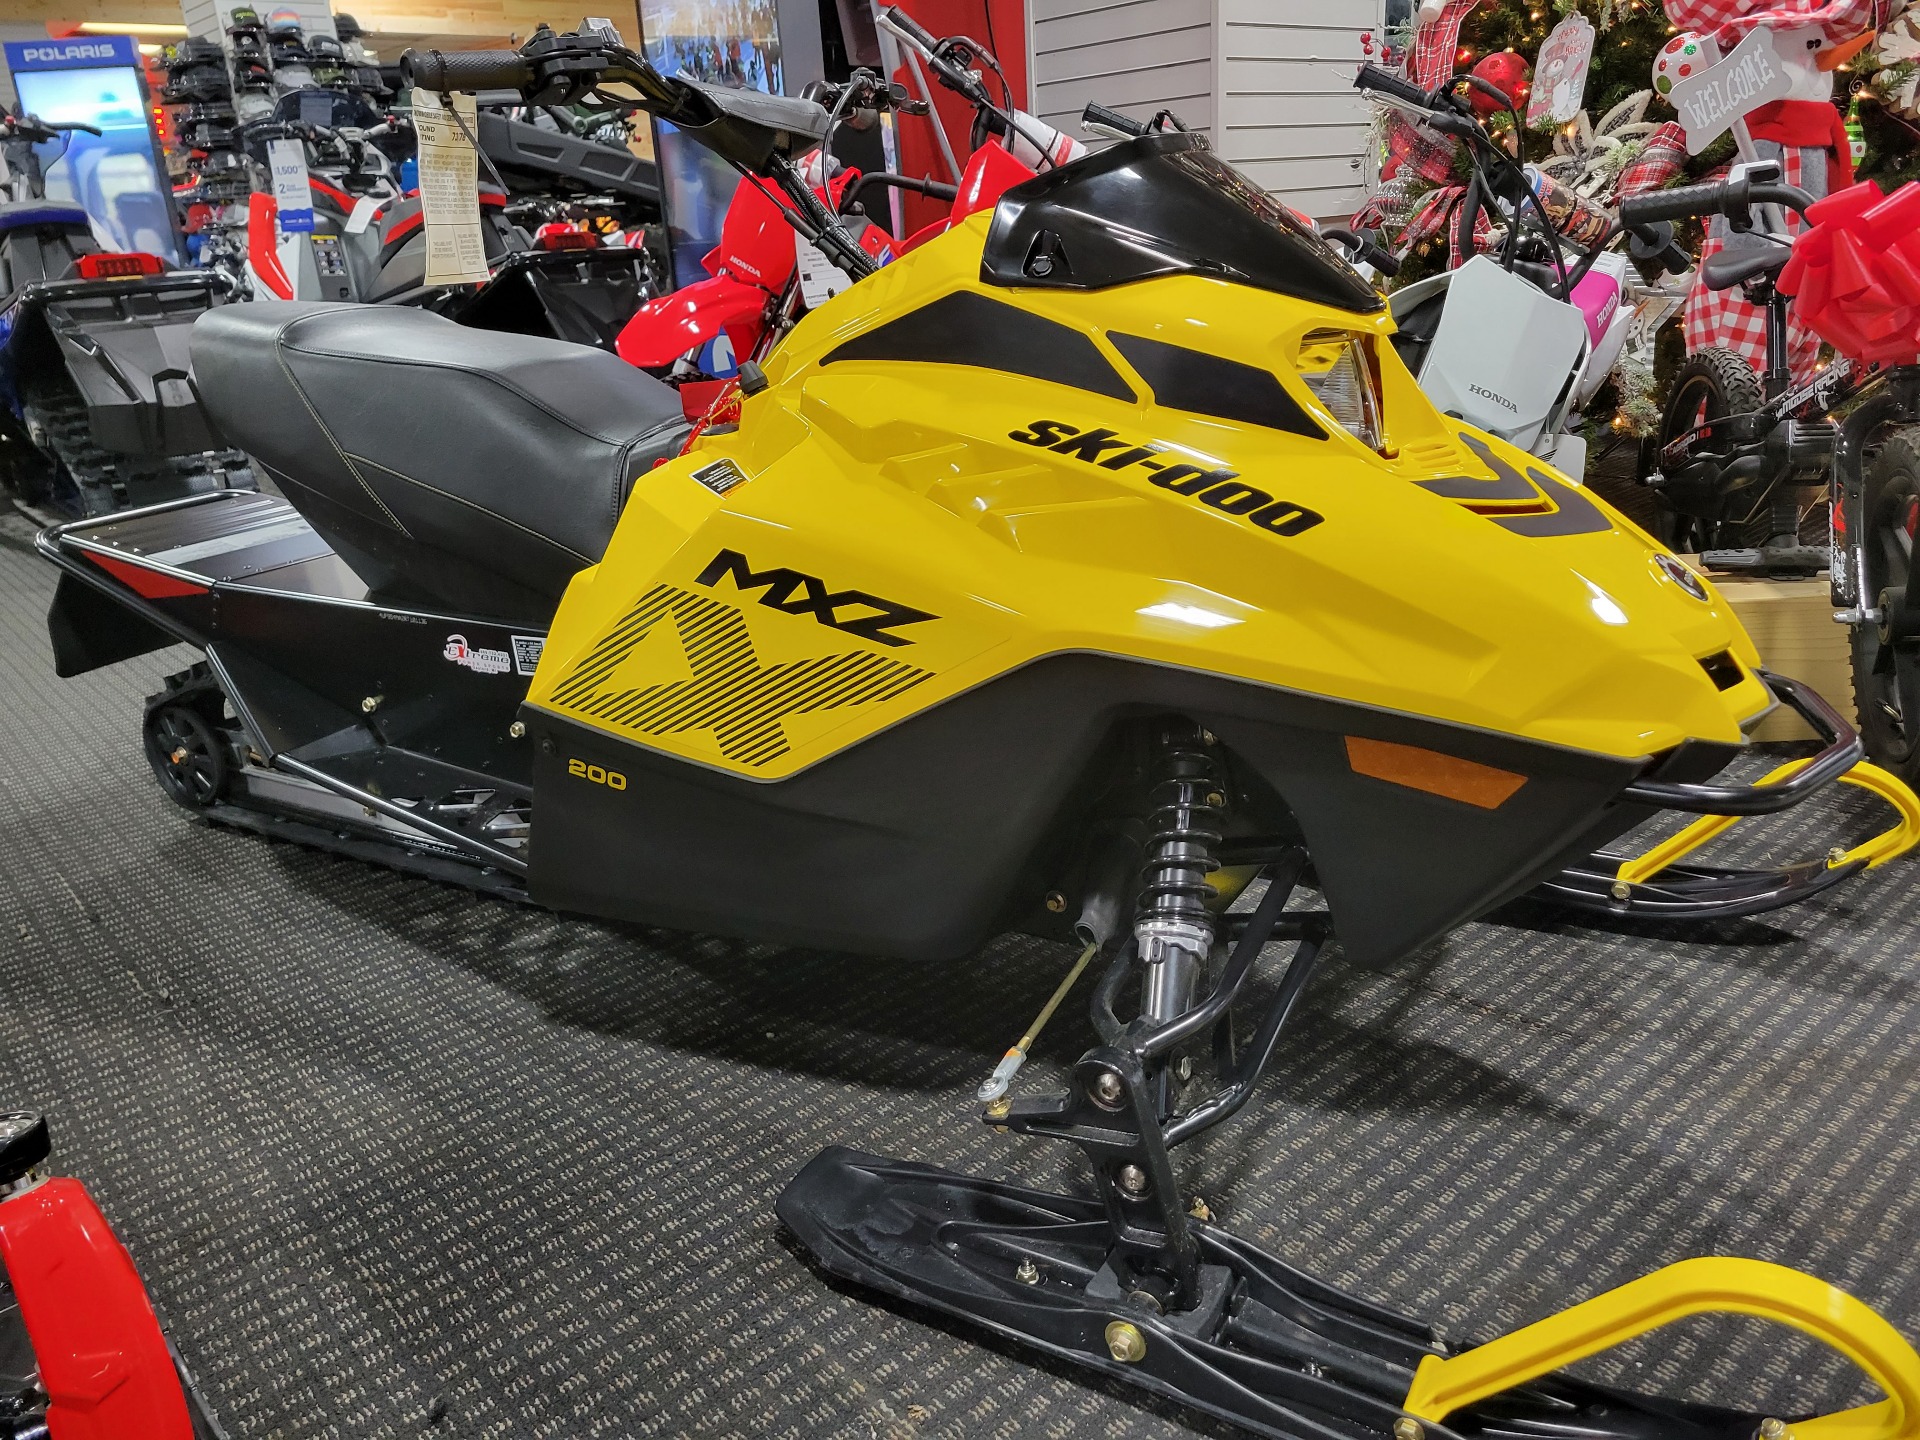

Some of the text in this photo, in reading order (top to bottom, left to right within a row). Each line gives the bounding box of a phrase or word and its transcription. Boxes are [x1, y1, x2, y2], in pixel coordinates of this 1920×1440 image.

[23, 44, 115, 62] POLARIS
[1684, 43, 1776, 130] WELCOME
[729, 255, 761, 278] HONDA
[1596, 291, 1618, 329] HONDA
[1469, 383, 1518, 414] HONDA
[1780, 359, 1850, 415] MOOSE RACING
[1008, 419, 1325, 538] ski-doo
[694, 548, 943, 648] MXZ
[569, 759, 627, 790] 200
